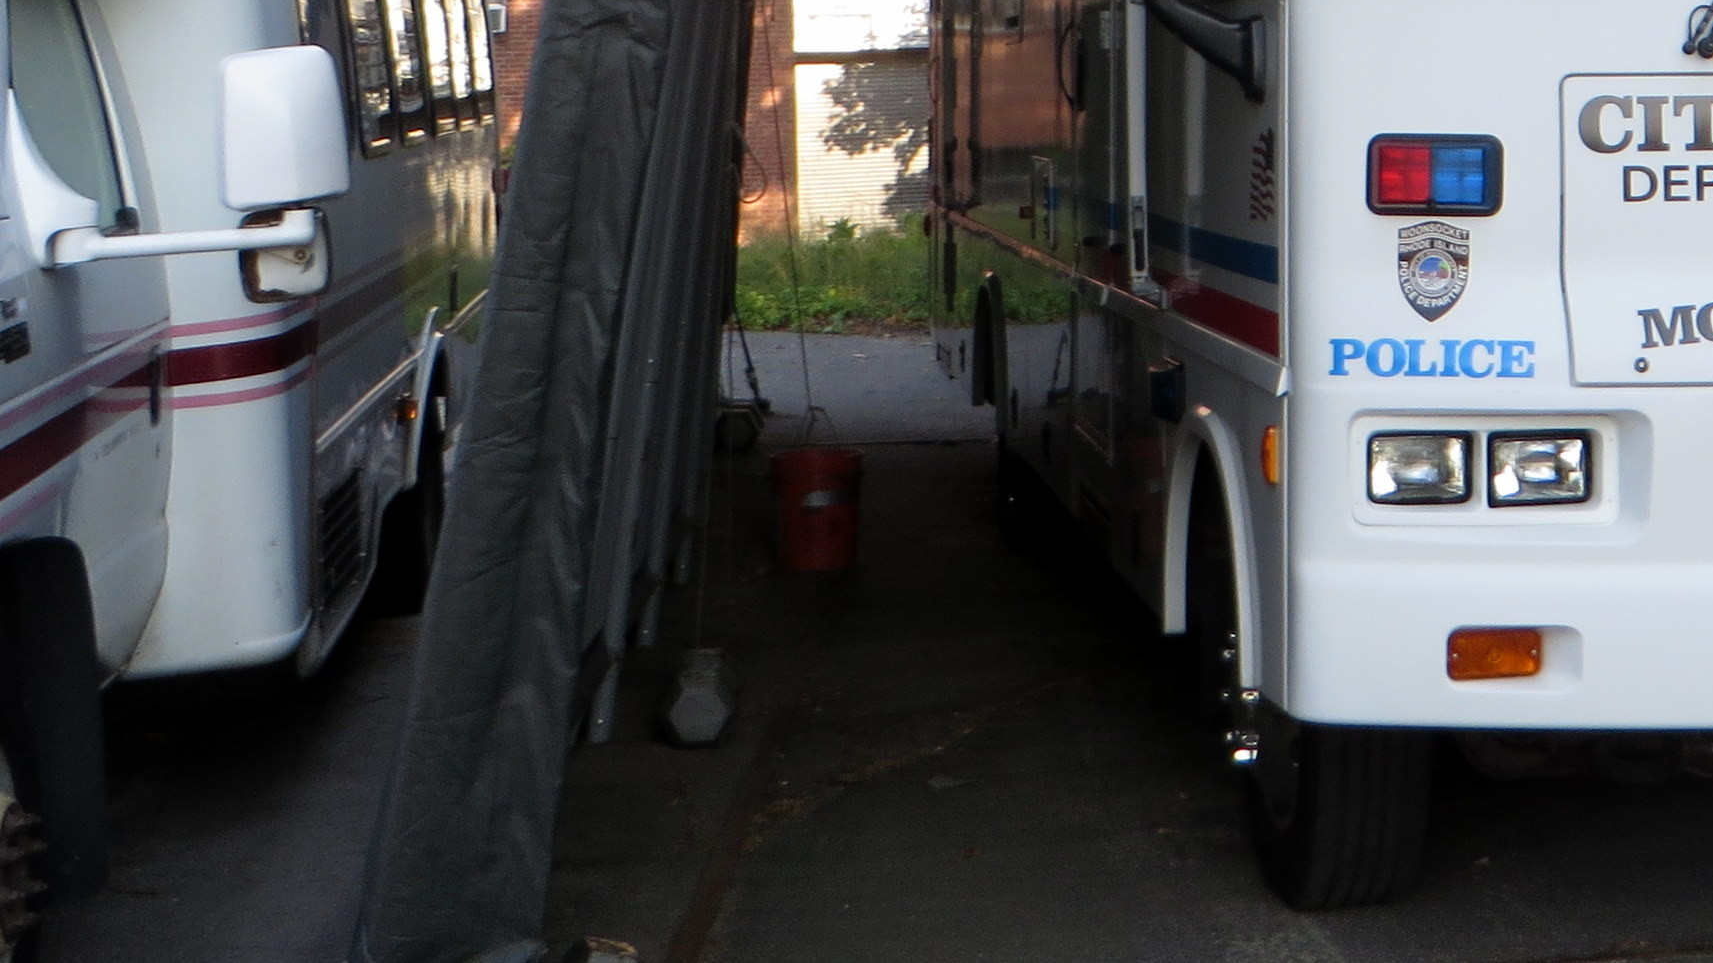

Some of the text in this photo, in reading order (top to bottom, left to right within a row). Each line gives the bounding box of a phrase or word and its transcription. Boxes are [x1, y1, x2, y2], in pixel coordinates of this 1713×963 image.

[1400, 223, 1467, 239] WOONSOCKET
[1399, 261, 1419, 300] POLICE
[1417, 264, 1468, 308] DEPARTMENT
[1328, 338, 1536, 379] POLICE
